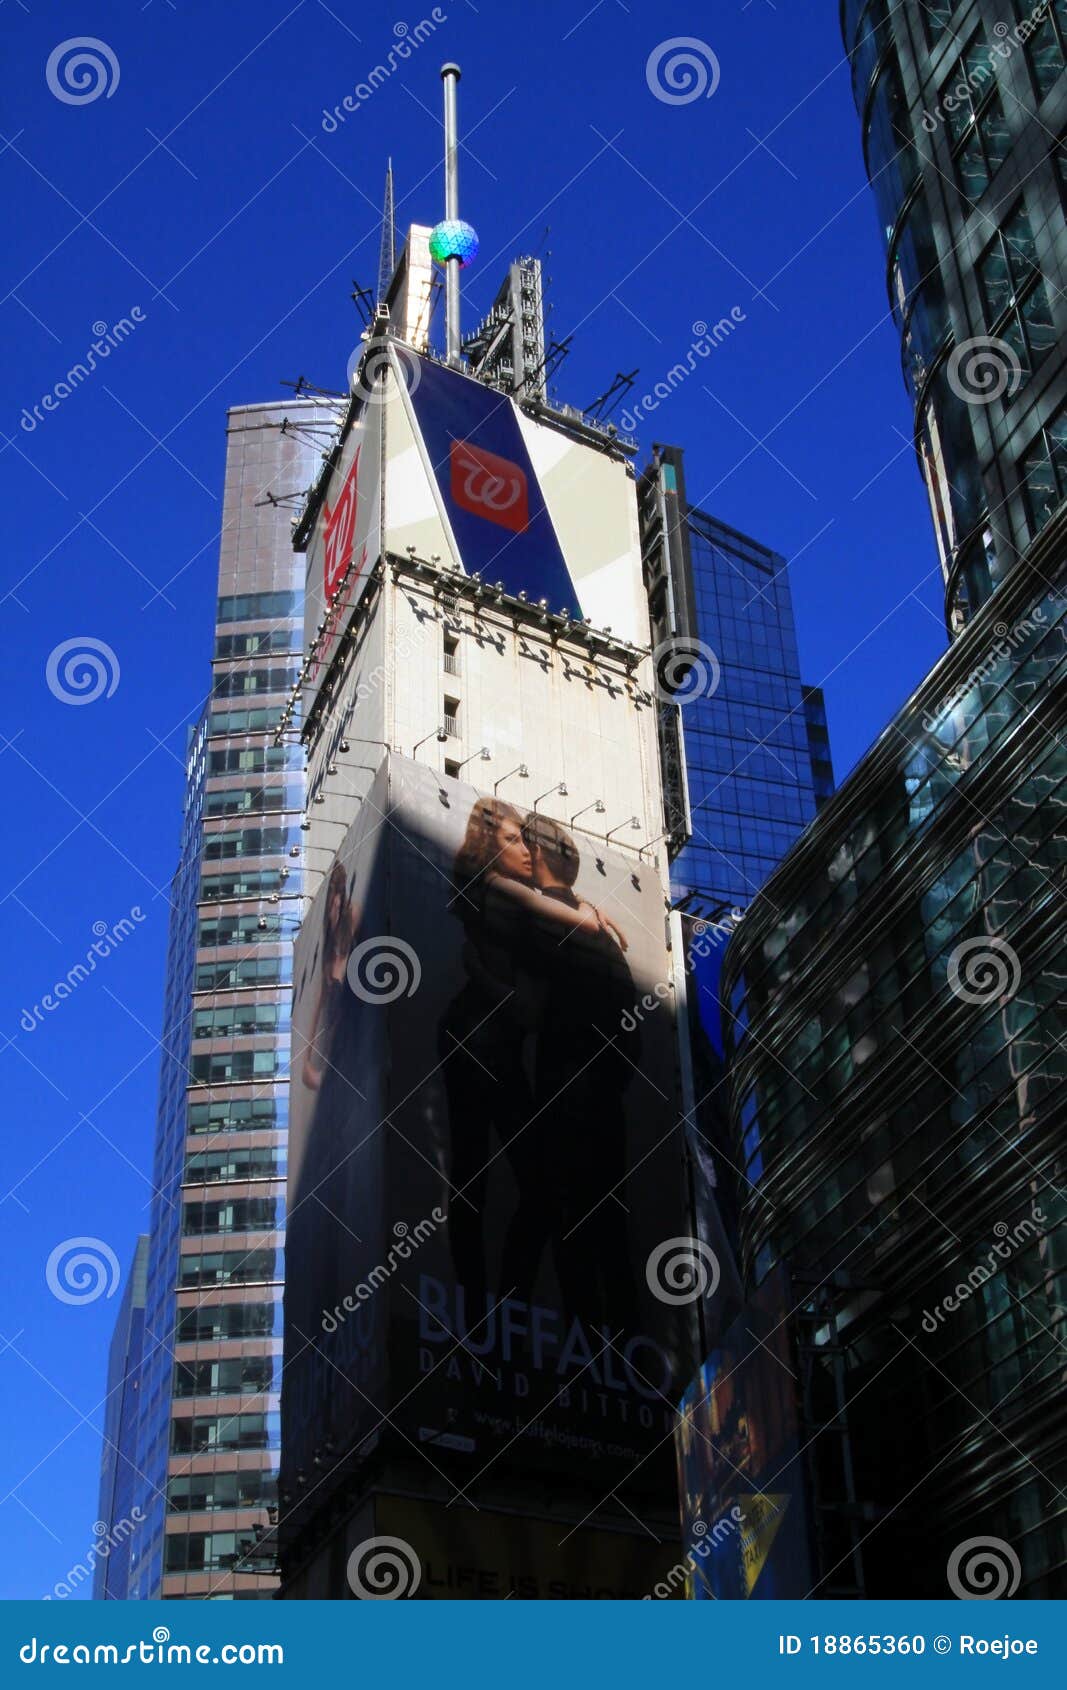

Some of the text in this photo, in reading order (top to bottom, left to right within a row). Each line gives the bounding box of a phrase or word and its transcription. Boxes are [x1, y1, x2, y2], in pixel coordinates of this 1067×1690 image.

[418, 1271, 673, 1400] BUFFALO
[418, 1347, 530, 1398] DAVID
[425, 1561, 500, 1597] LIFE
